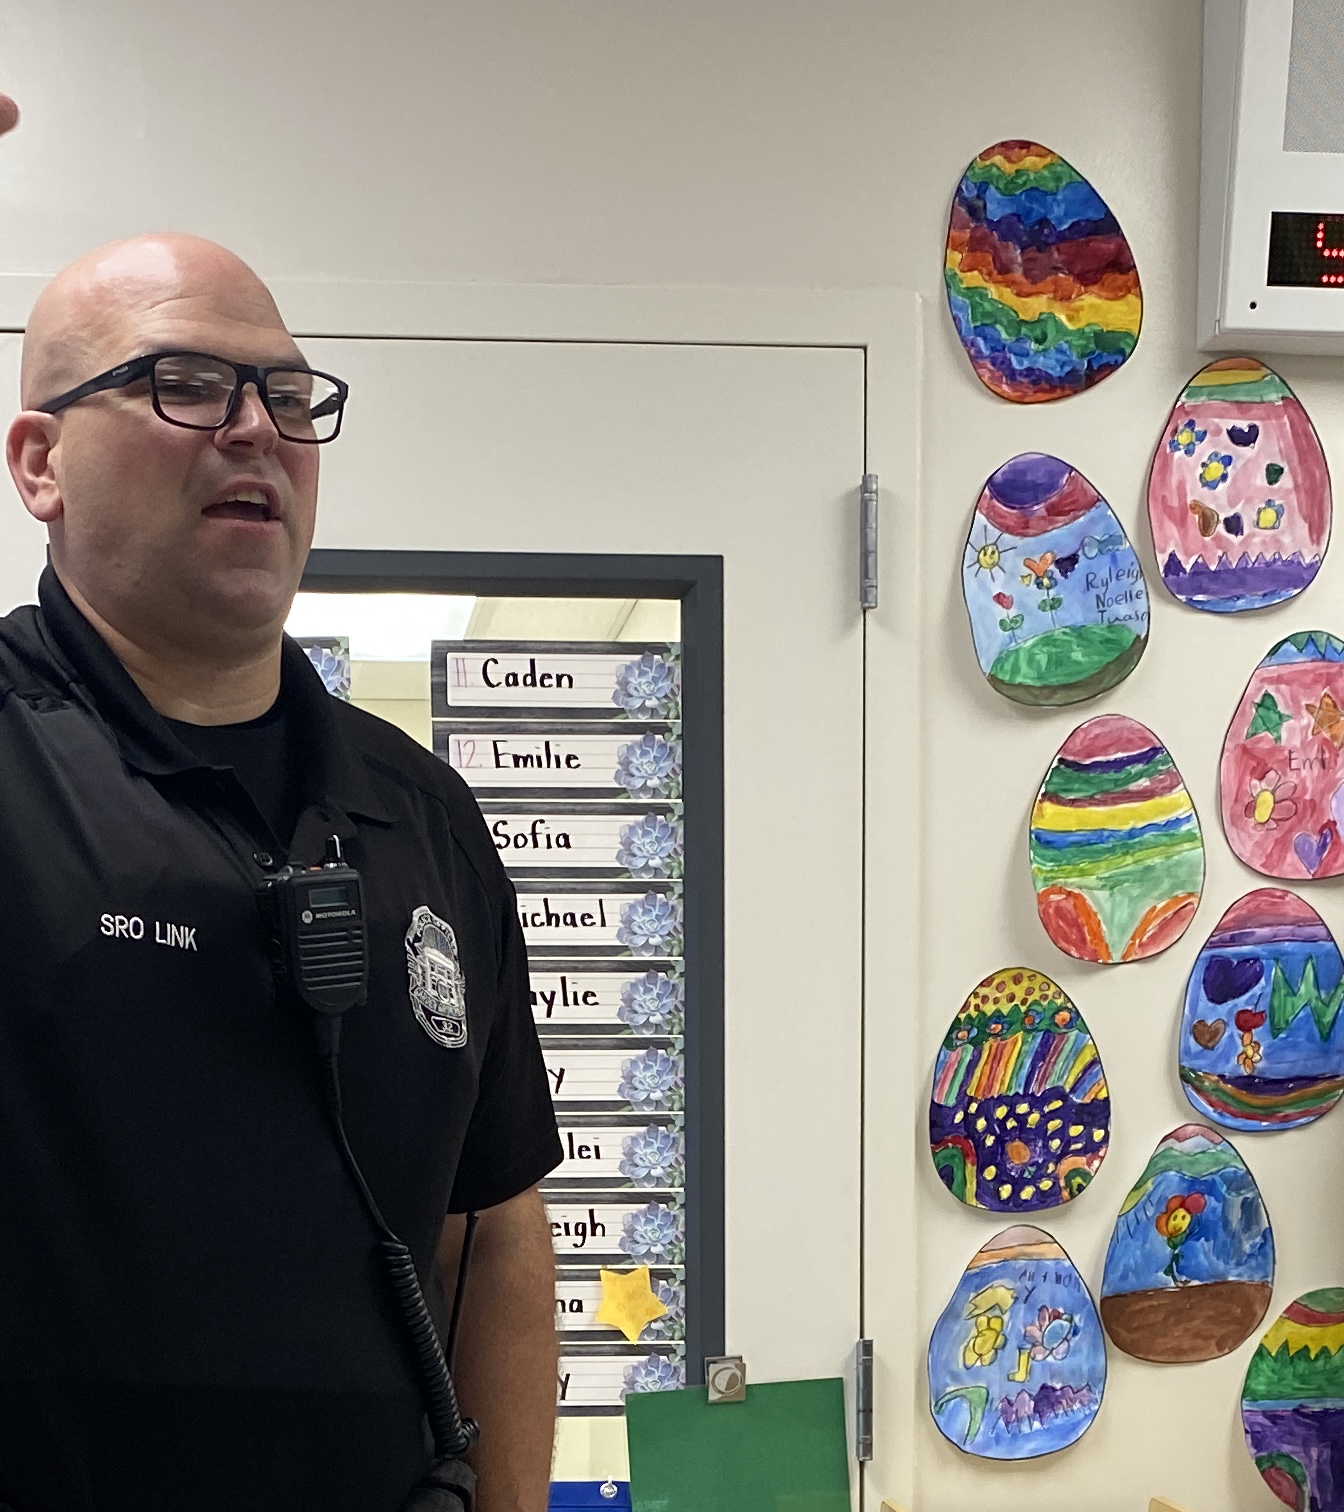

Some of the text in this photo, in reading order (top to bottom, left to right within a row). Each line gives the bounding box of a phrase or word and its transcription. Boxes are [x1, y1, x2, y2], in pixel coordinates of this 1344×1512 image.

[1095, 589, 1144, 609] Noelle
[482, 657, 575, 690] Caden
[492, 739, 582, 770] Emilie
[493, 818, 572, 850] Sofia
[520, 897, 607, 928] ichael
[100, 913, 198, 952] SRO LINK
[567, 1131, 601, 1160] lei
[551, 1208, 606, 1249] eigh
